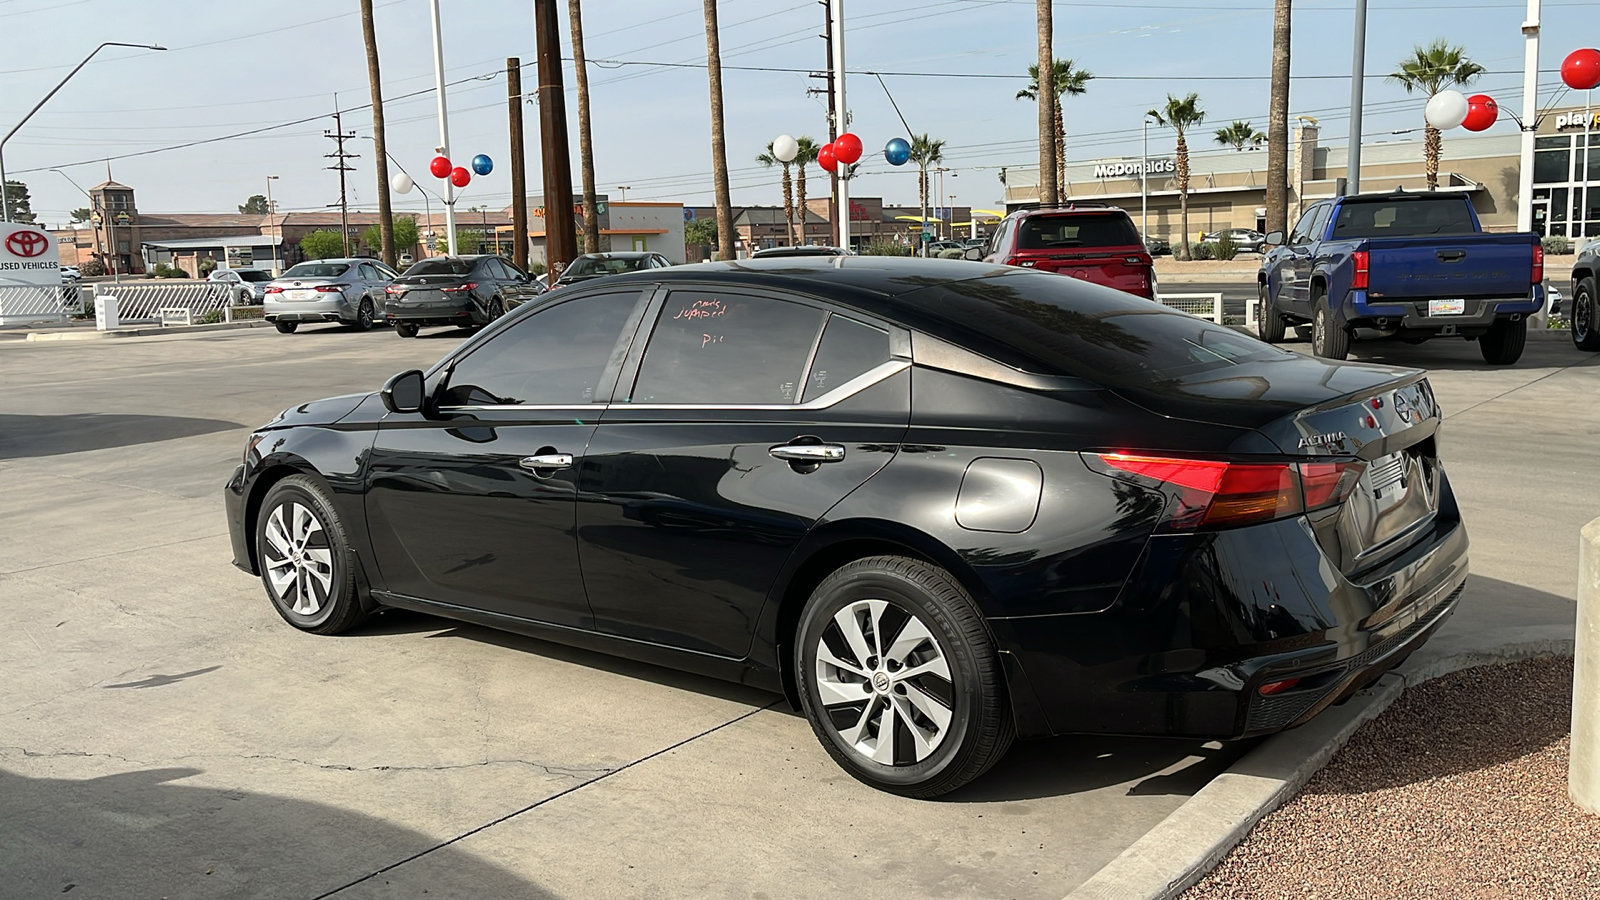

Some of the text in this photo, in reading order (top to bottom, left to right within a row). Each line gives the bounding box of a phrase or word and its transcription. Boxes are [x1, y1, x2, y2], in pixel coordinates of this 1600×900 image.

[1094, 159, 1175, 177] McDonald's
[21, 261, 59, 270] VEHICLES
[1297, 431, 1348, 449] ALTIMA
